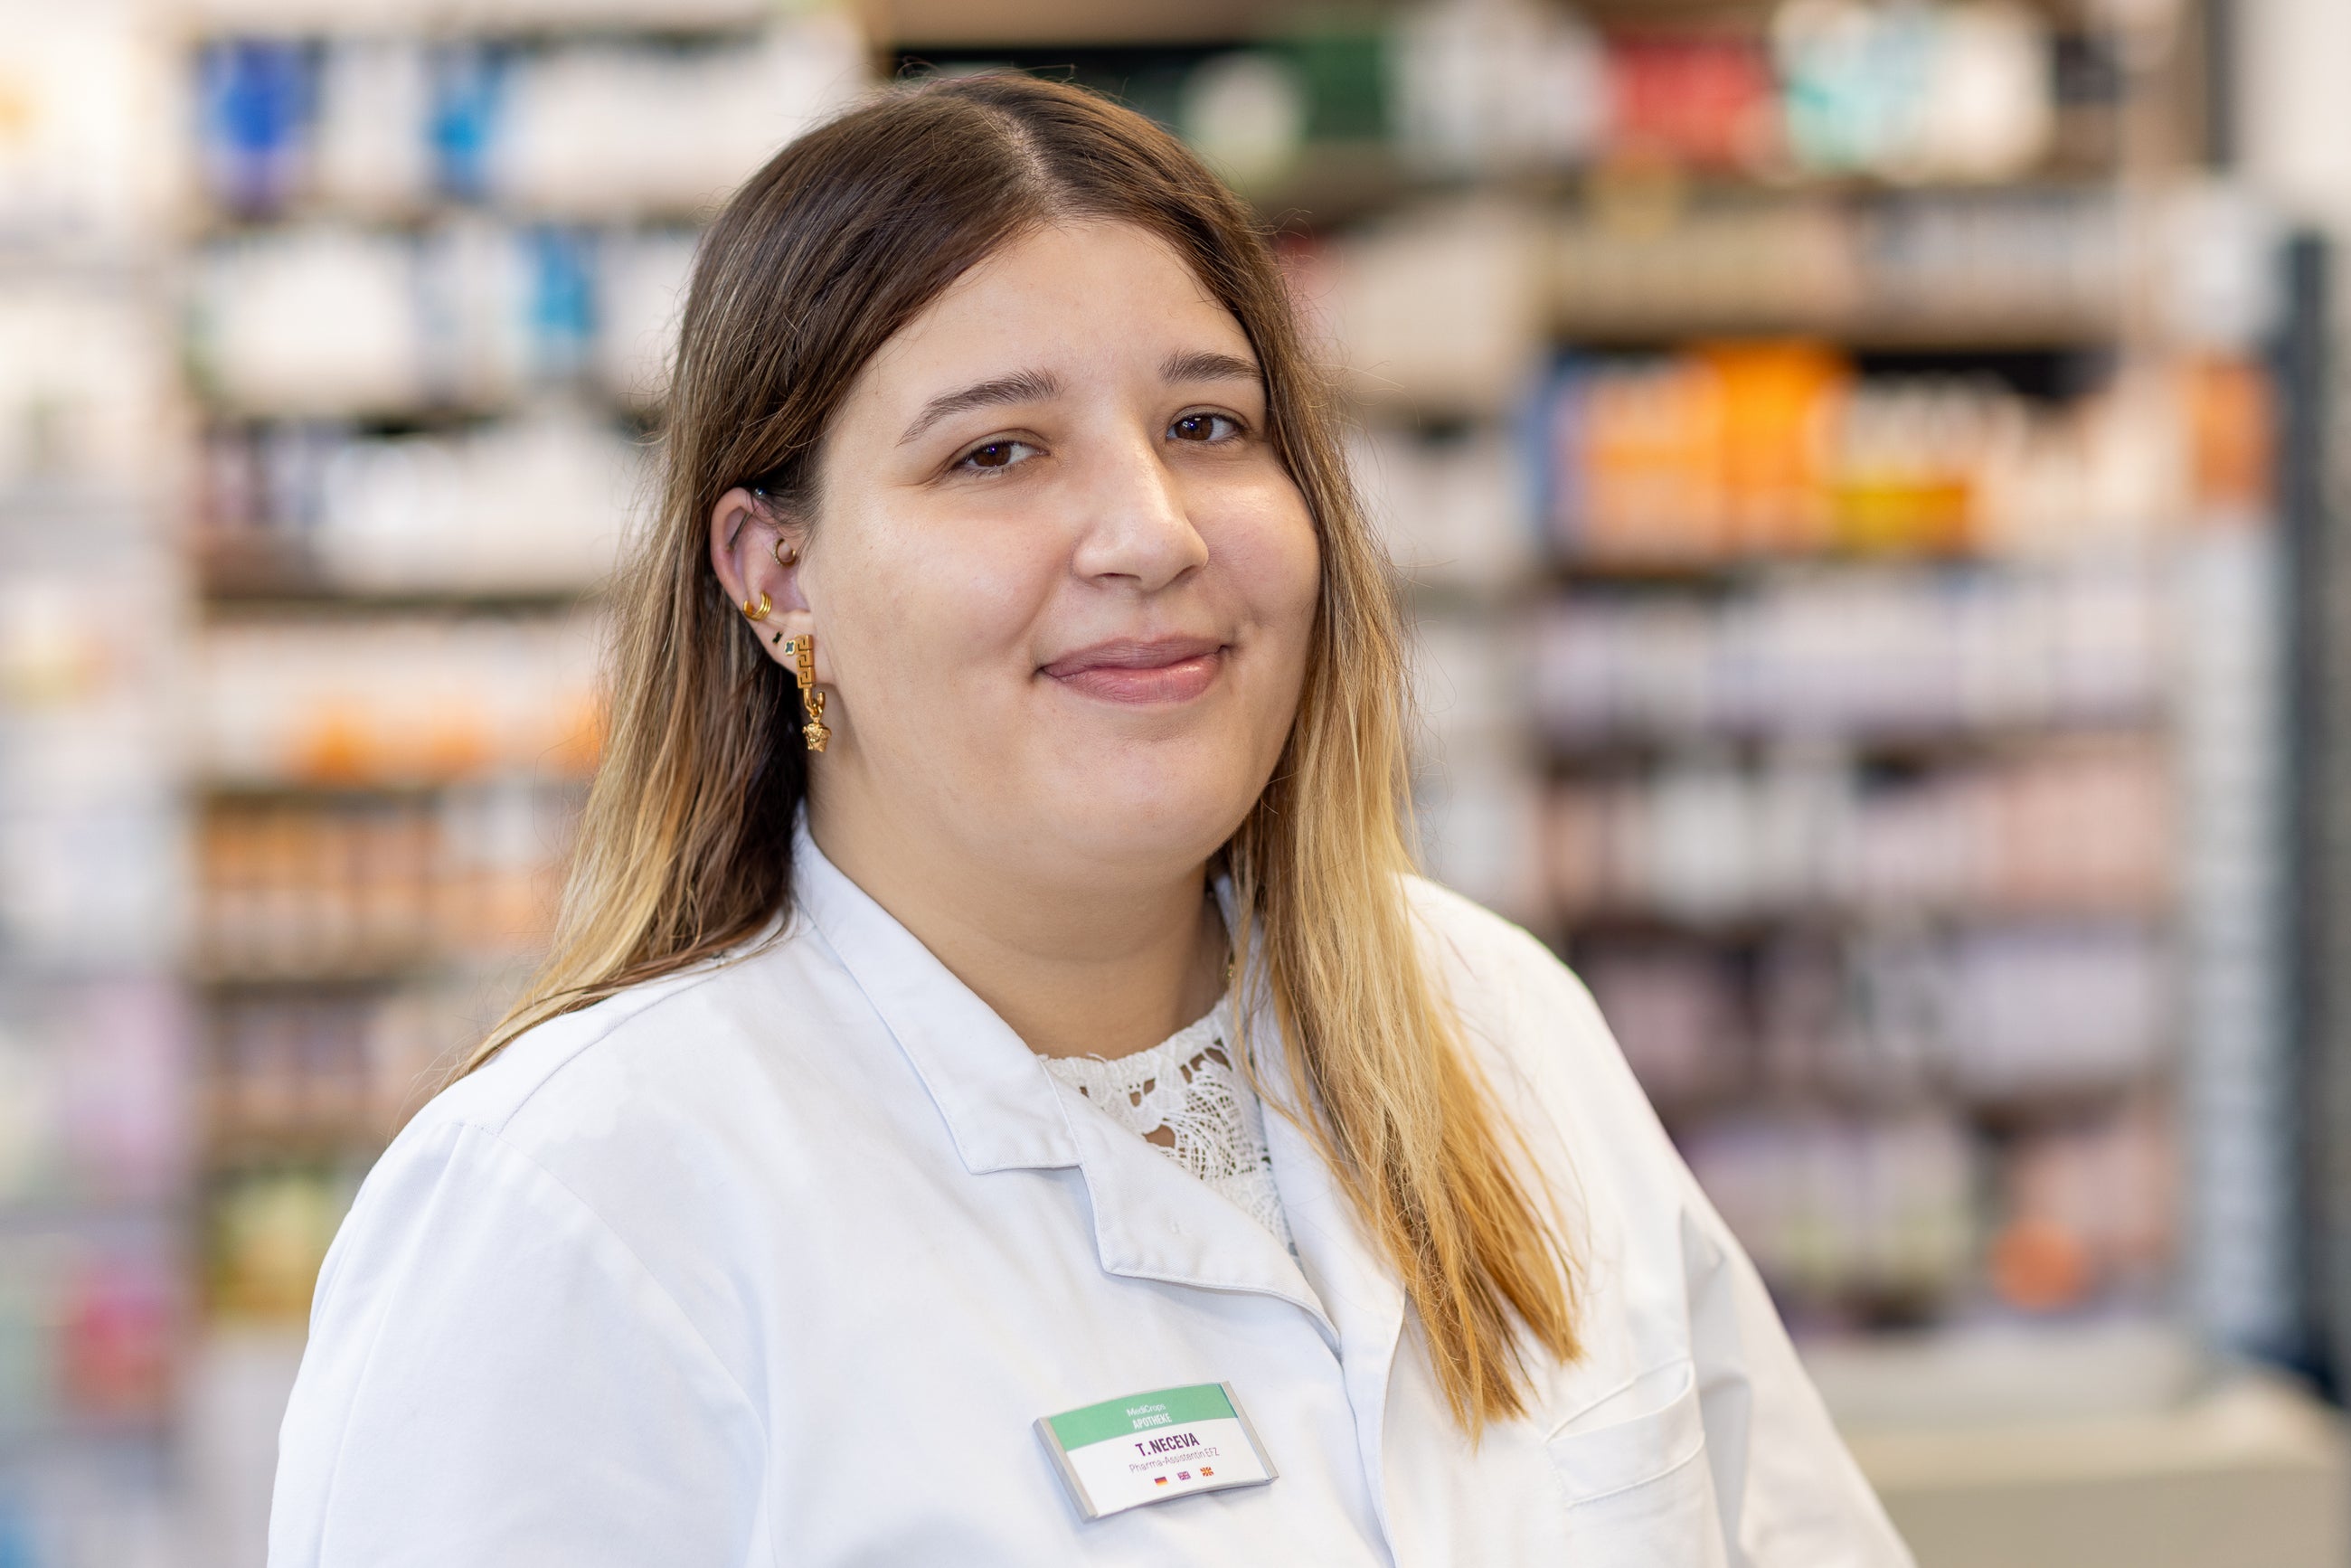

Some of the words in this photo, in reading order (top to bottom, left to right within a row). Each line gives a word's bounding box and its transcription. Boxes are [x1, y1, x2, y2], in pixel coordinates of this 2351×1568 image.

[1132, 1412, 1173, 1430] APOTHEKE
[1148, 1432, 1200, 1454] NECEVA
[1128, 1450, 1206, 1474] Pharma-Assistentin
[1204, 1447, 1220, 1459] EFZ
